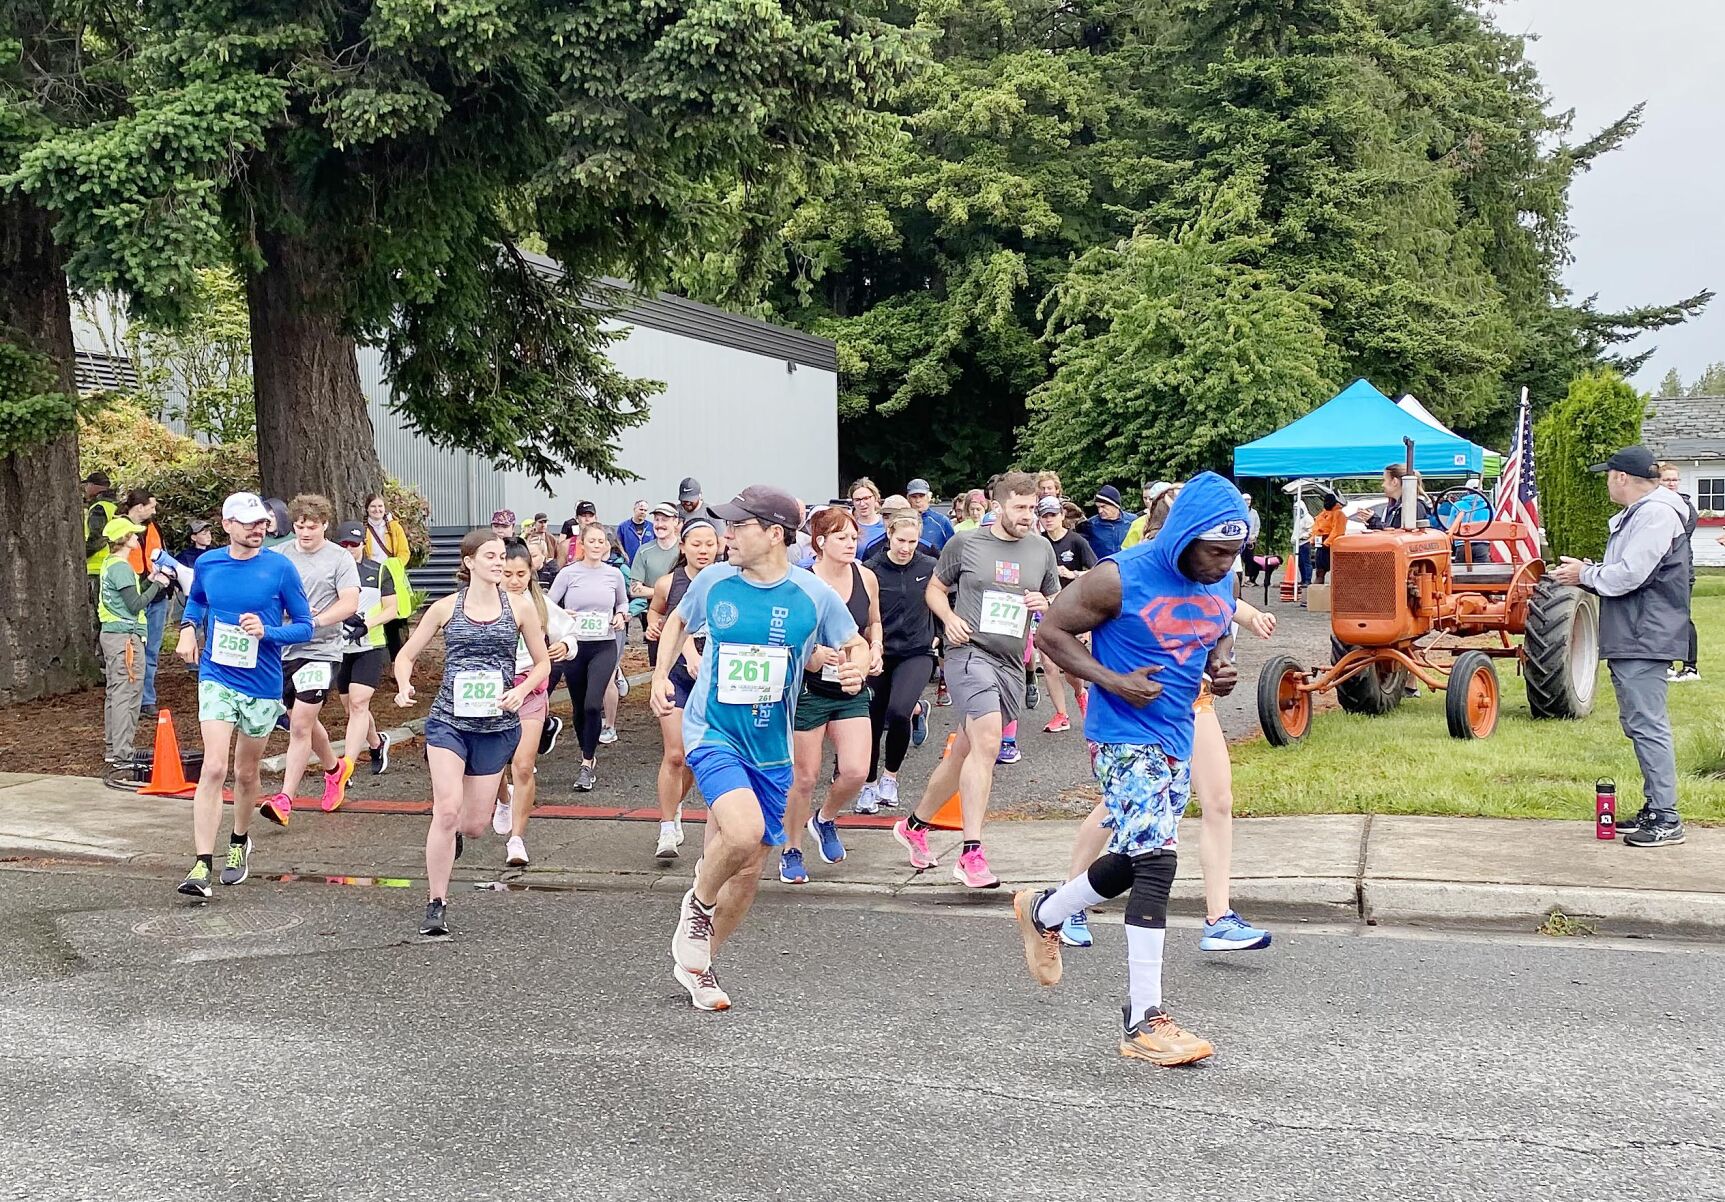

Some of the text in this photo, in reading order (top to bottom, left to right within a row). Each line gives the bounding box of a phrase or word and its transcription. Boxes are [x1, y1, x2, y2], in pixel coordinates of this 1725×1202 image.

[990, 602, 1020, 620] 277
[581, 619, 602, 630] 263
[219, 634, 250, 652] 258
[299, 670, 324, 684] 278
[728, 659, 771, 682] 261
[463, 682, 496, 699] 282
[759, 694, 772, 702] 261
